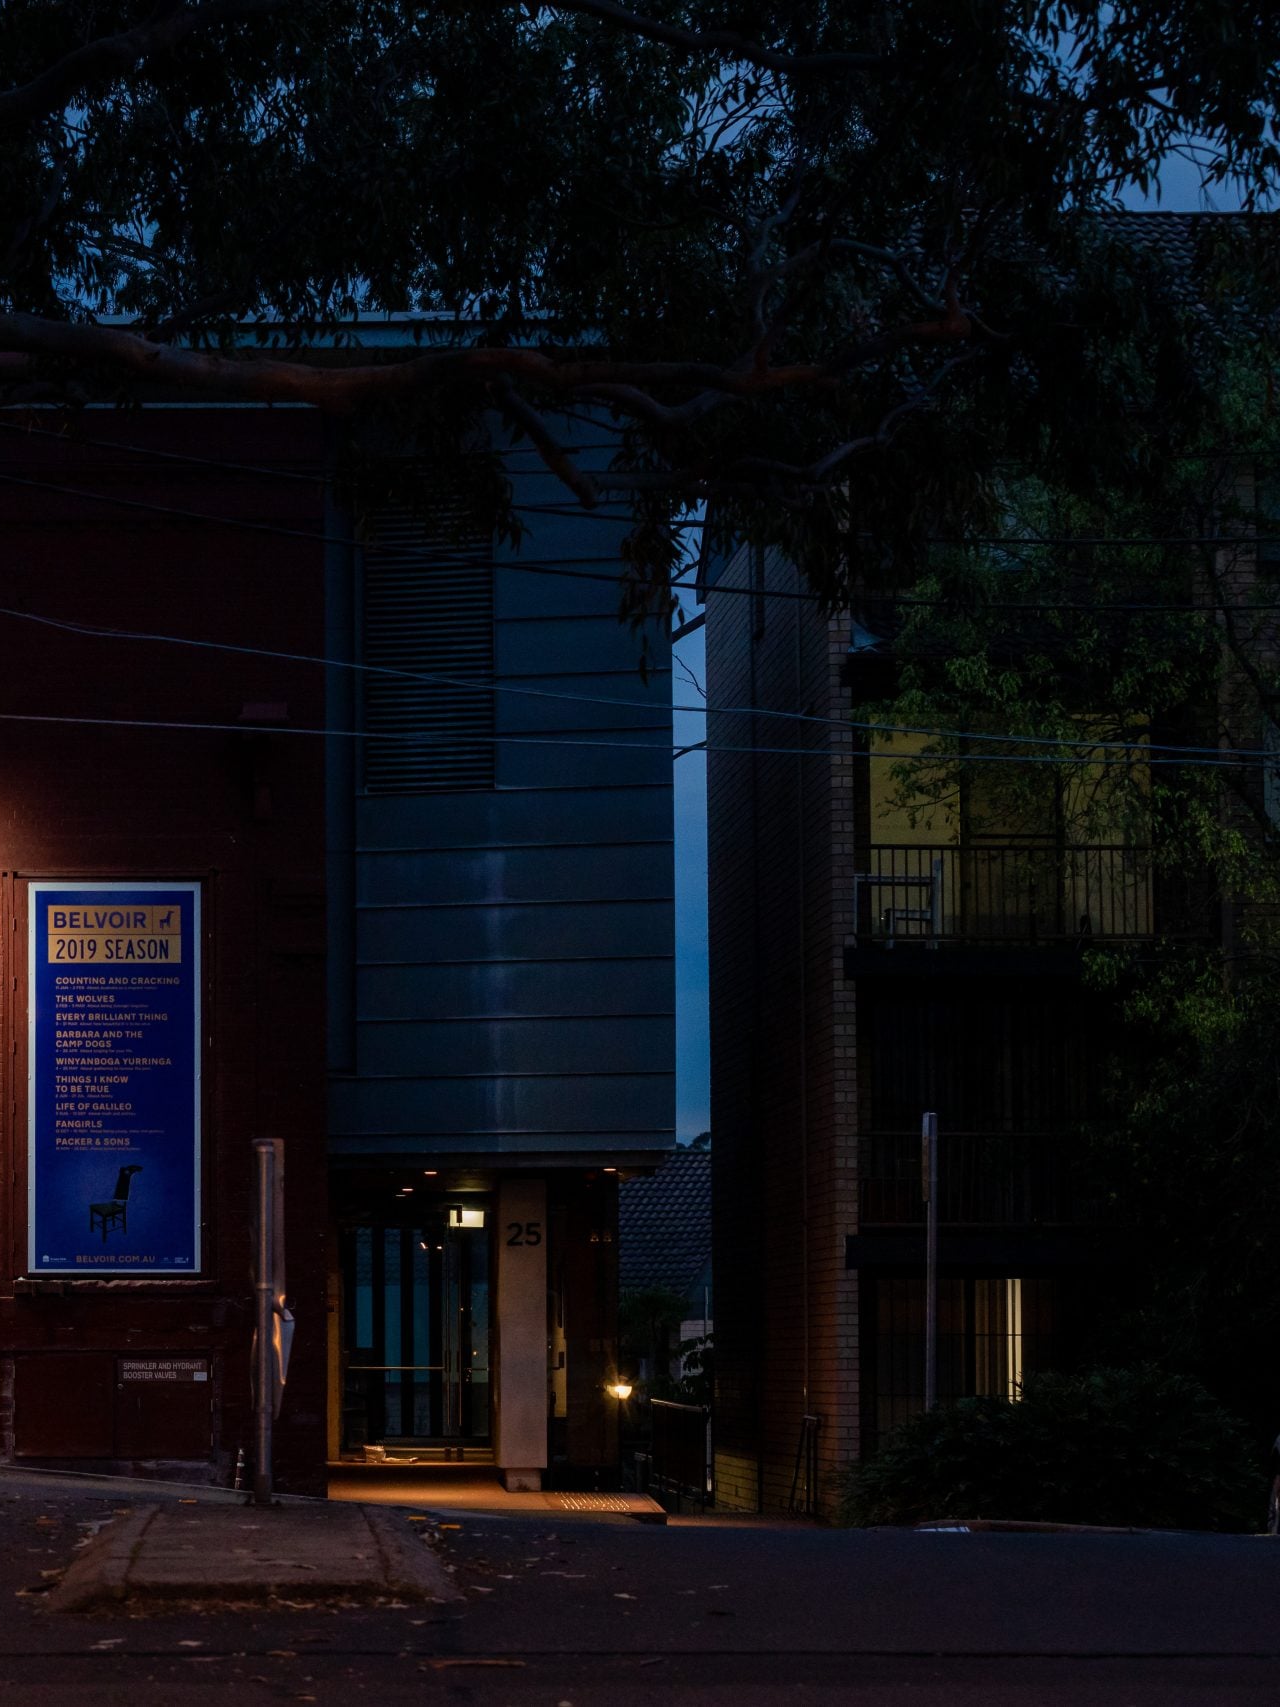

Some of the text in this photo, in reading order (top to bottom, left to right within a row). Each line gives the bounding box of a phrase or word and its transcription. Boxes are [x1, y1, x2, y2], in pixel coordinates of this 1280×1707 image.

[54, 912, 146, 928] BELVOIR
[56, 940, 169, 960] 2019 SEASON
[506, 1222, 542, 1246] 25
